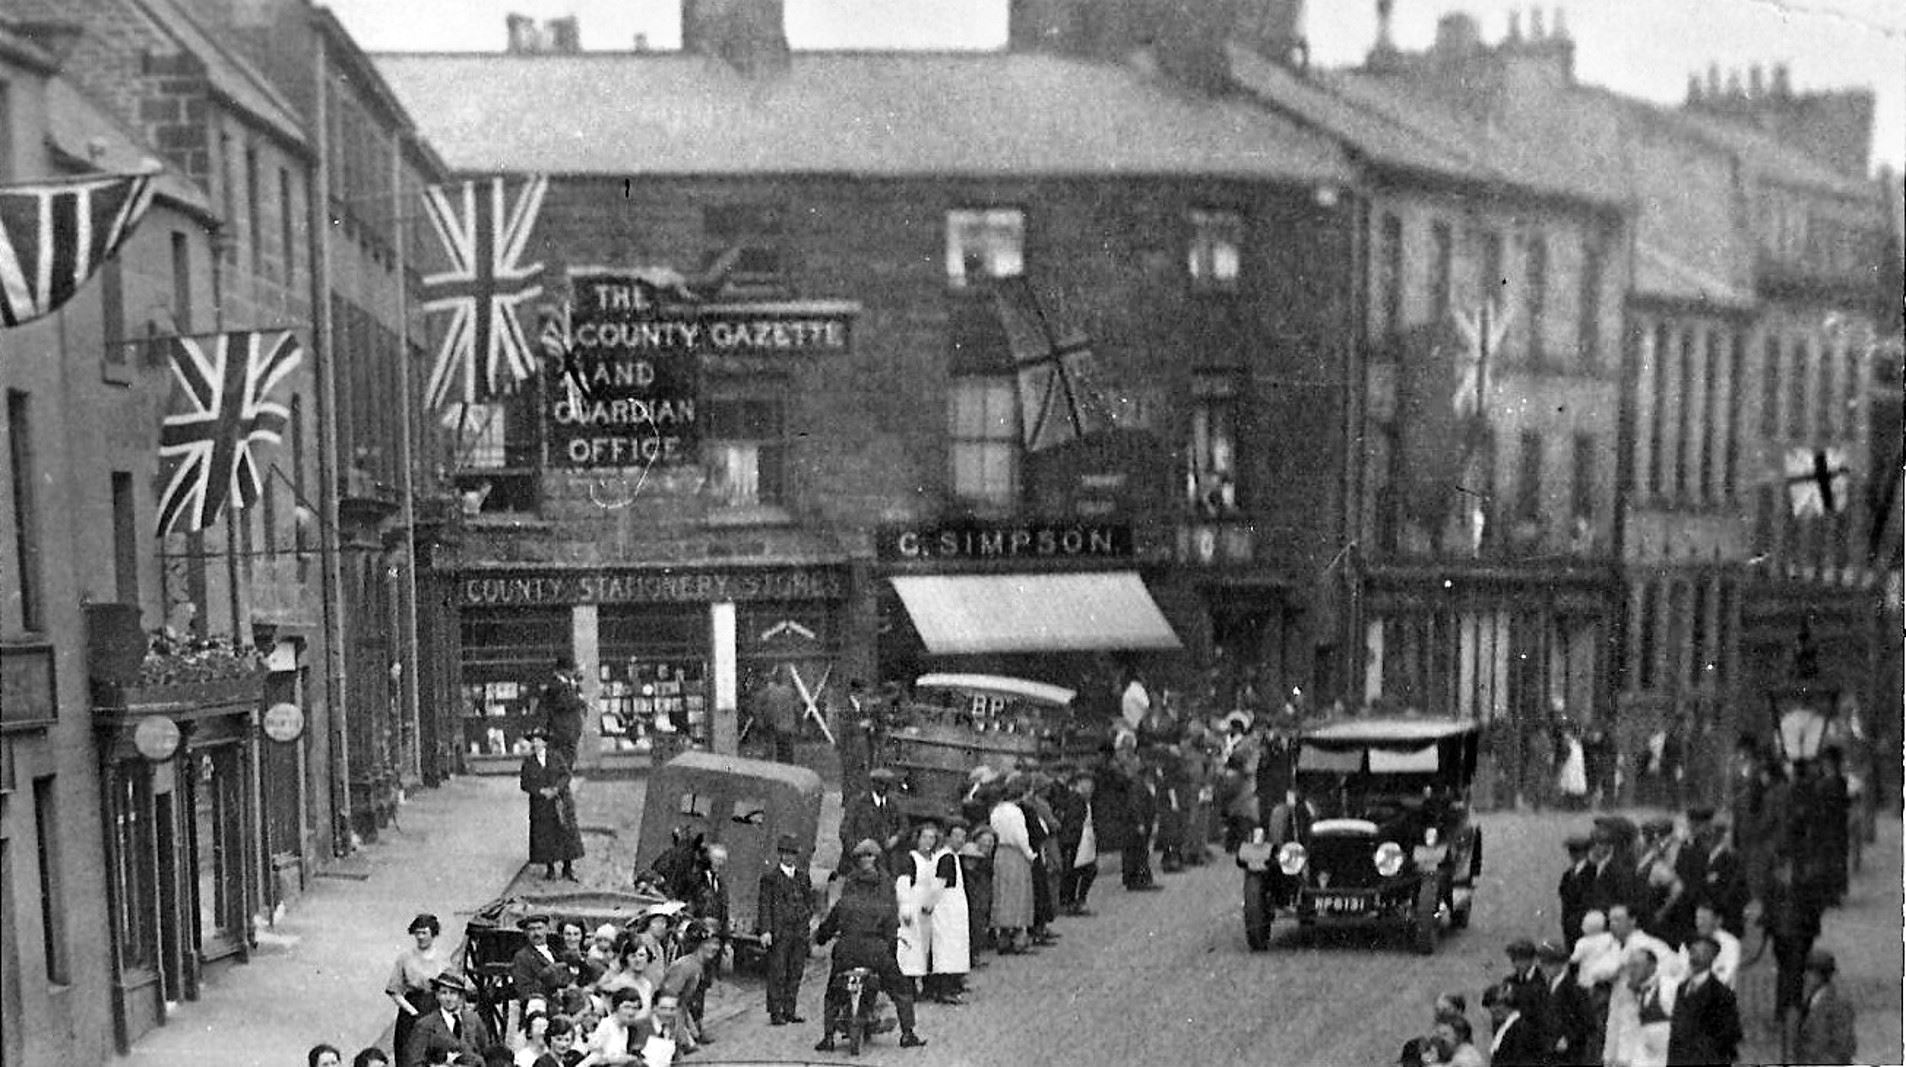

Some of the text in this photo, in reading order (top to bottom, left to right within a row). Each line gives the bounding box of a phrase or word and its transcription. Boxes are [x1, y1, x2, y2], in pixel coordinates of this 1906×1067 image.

[595, 284, 651, 311] THE
[577, 322, 844, 348] COUNTY GAZETTE
[594, 361, 655, 386] AND
[569, 437, 681, 462] OFFICE
[467, 578, 563, 602] COUNTY
[579, 574, 730, 600] STATIONERY
